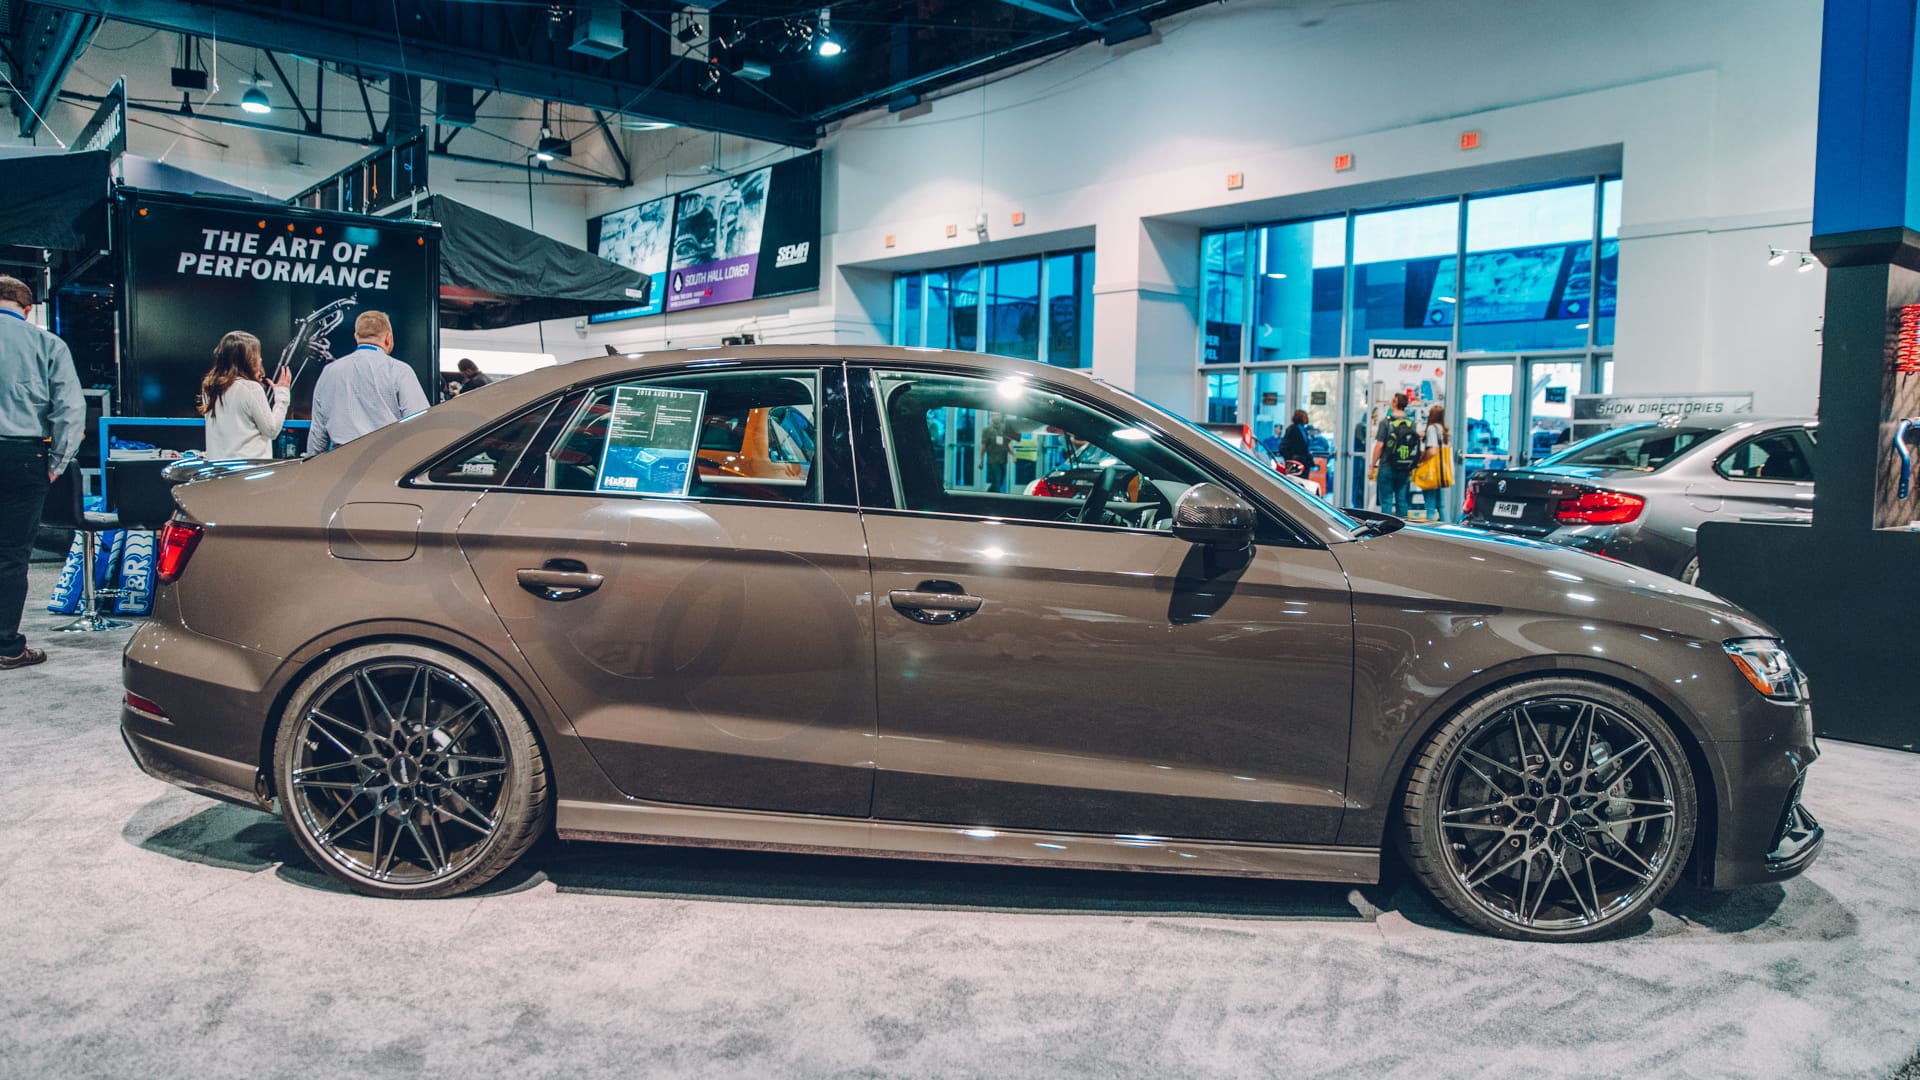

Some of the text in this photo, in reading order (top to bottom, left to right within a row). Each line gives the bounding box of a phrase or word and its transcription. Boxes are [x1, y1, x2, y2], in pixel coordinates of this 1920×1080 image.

[202, 228, 369, 264] THE ART OF
[777, 241, 809, 262] SEMA
[176, 251, 391, 290] PERFORMANCE
[685, 263, 750, 287] SOUTH HALL LOWER
[1376, 348, 1446, 359] YOU ARE HERE
[1595, 402, 1724, 415] SHOW DIRECTORIES
[120, 559, 149, 610] H&R
